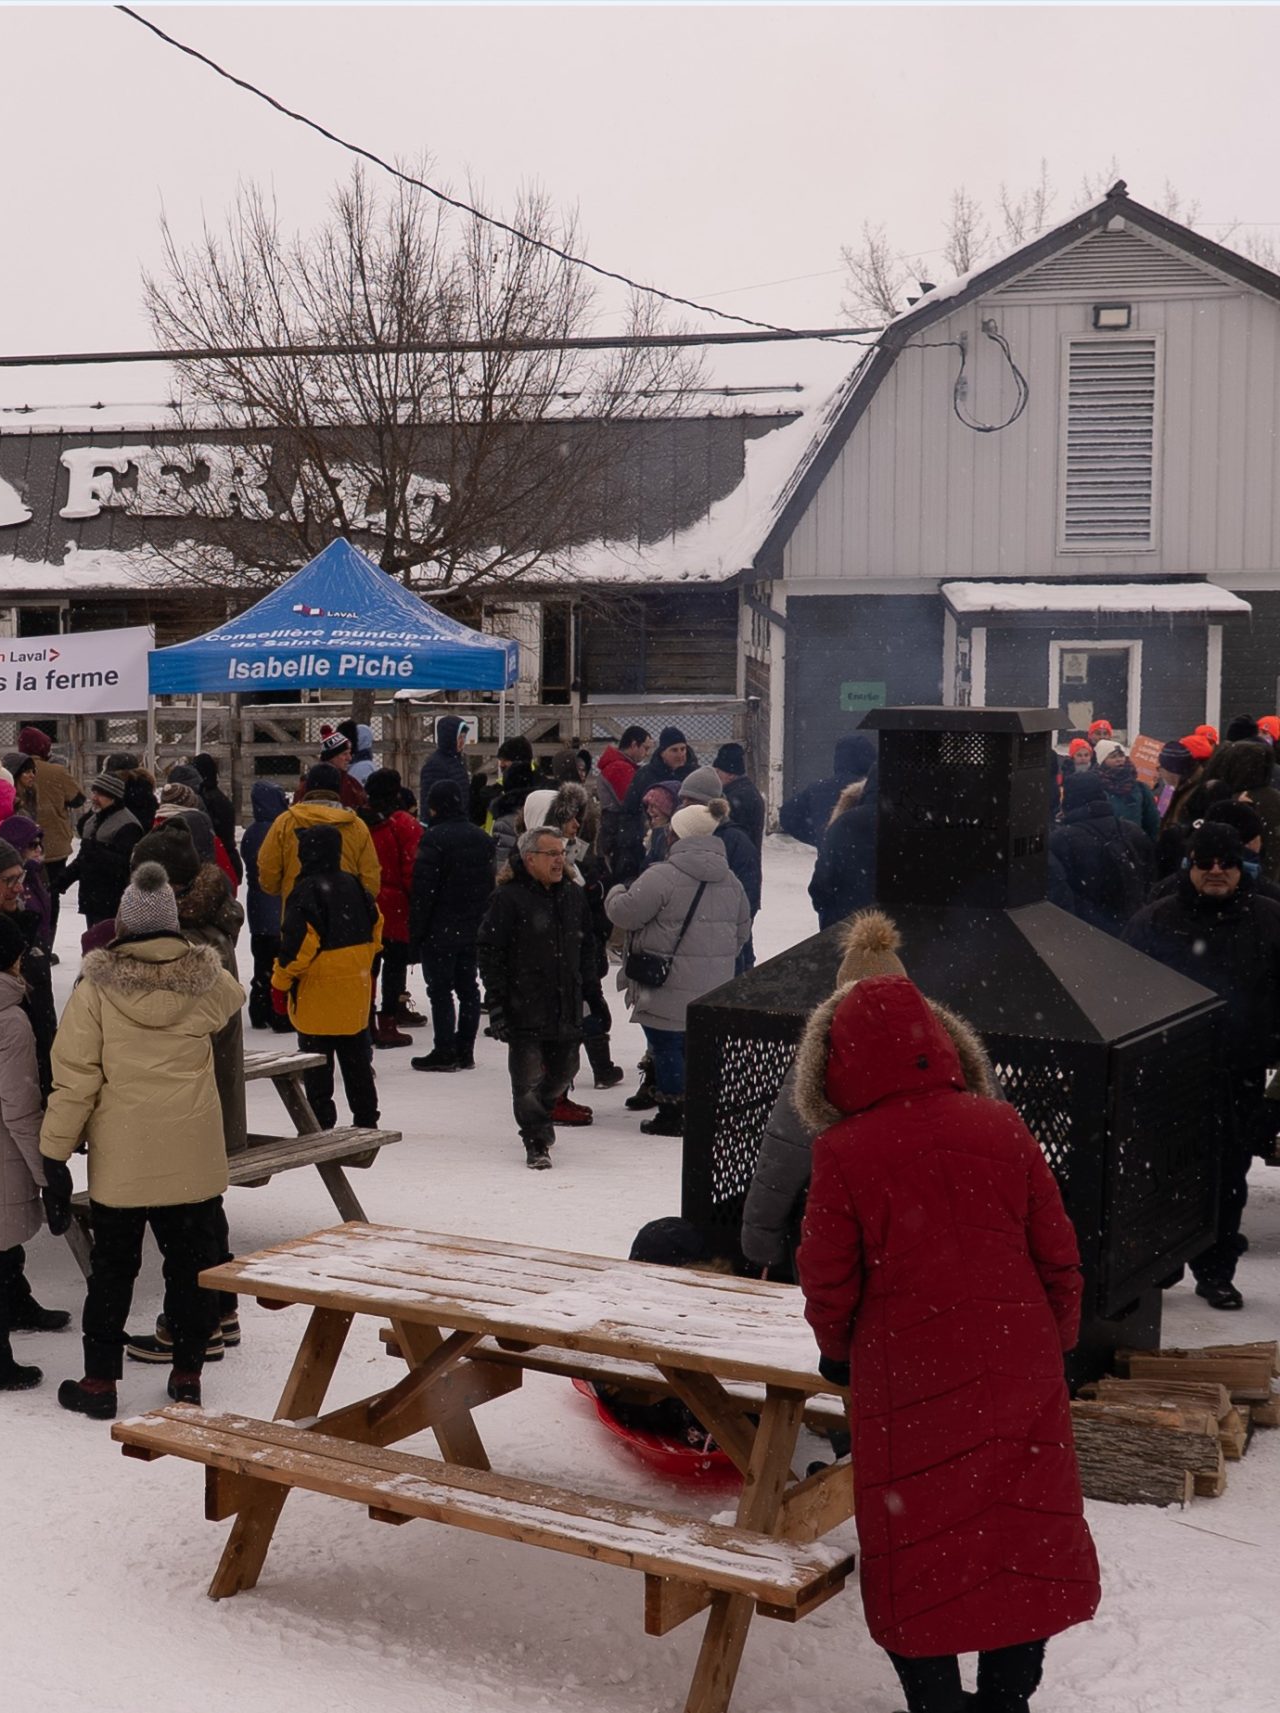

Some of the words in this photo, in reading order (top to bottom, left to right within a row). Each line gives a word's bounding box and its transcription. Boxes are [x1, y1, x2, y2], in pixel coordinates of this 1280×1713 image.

[326, 611, 359, 619] LAVAL
[330, 630, 453, 641] municipale
[10, 649, 47, 663] Laval
[228, 655, 330, 679] Isabelle
[338, 653, 413, 677] Piché
[15, 671, 37, 691] la
[45, 669, 119, 690] ferme
